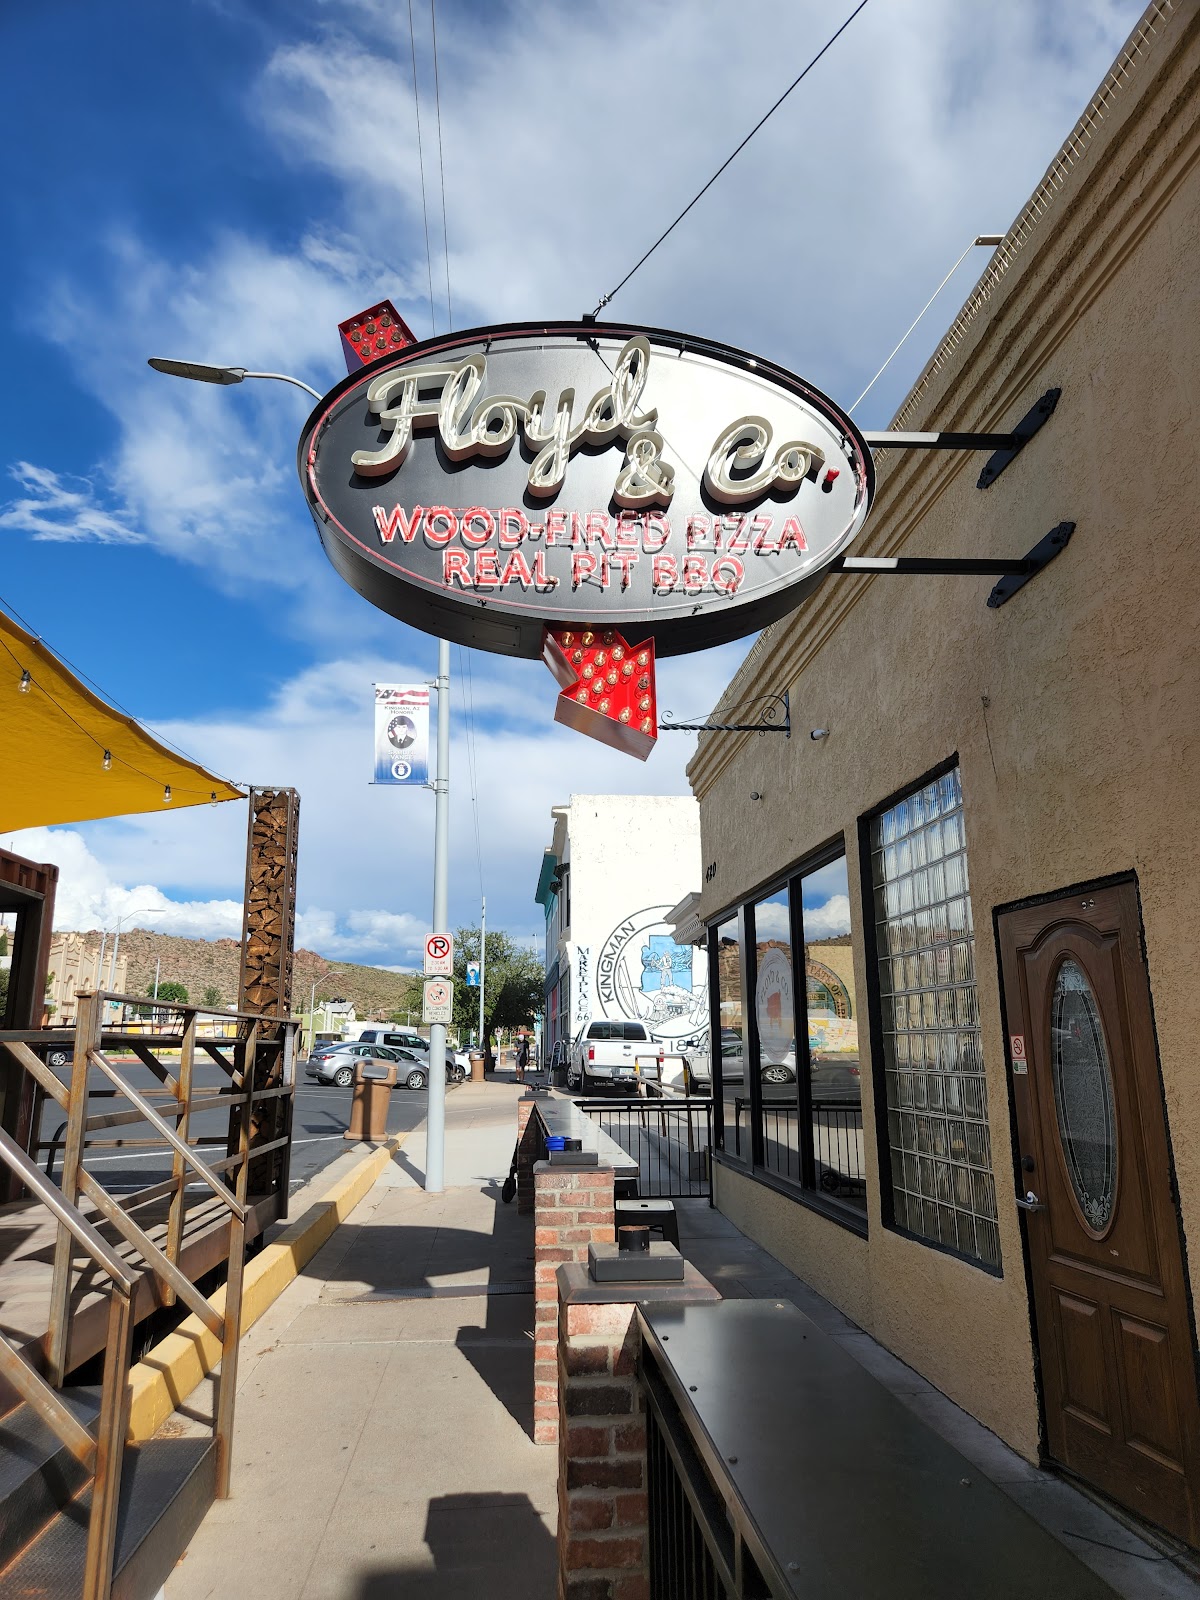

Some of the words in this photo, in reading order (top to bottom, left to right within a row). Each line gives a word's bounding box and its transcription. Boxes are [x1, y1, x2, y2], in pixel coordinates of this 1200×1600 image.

[351, 335, 658, 498] Floyd
[615, 430, 675, 508] &
[373, 504, 672, 548] WOOD-FIRED
[685, 512, 809, 551] PIZZA
[443, 547, 560, 586] REAL
[571, 549, 640, 588] PIT
[652, 553, 745, 594] BBQ
[600, 921, 636, 1004] KINGMAN
